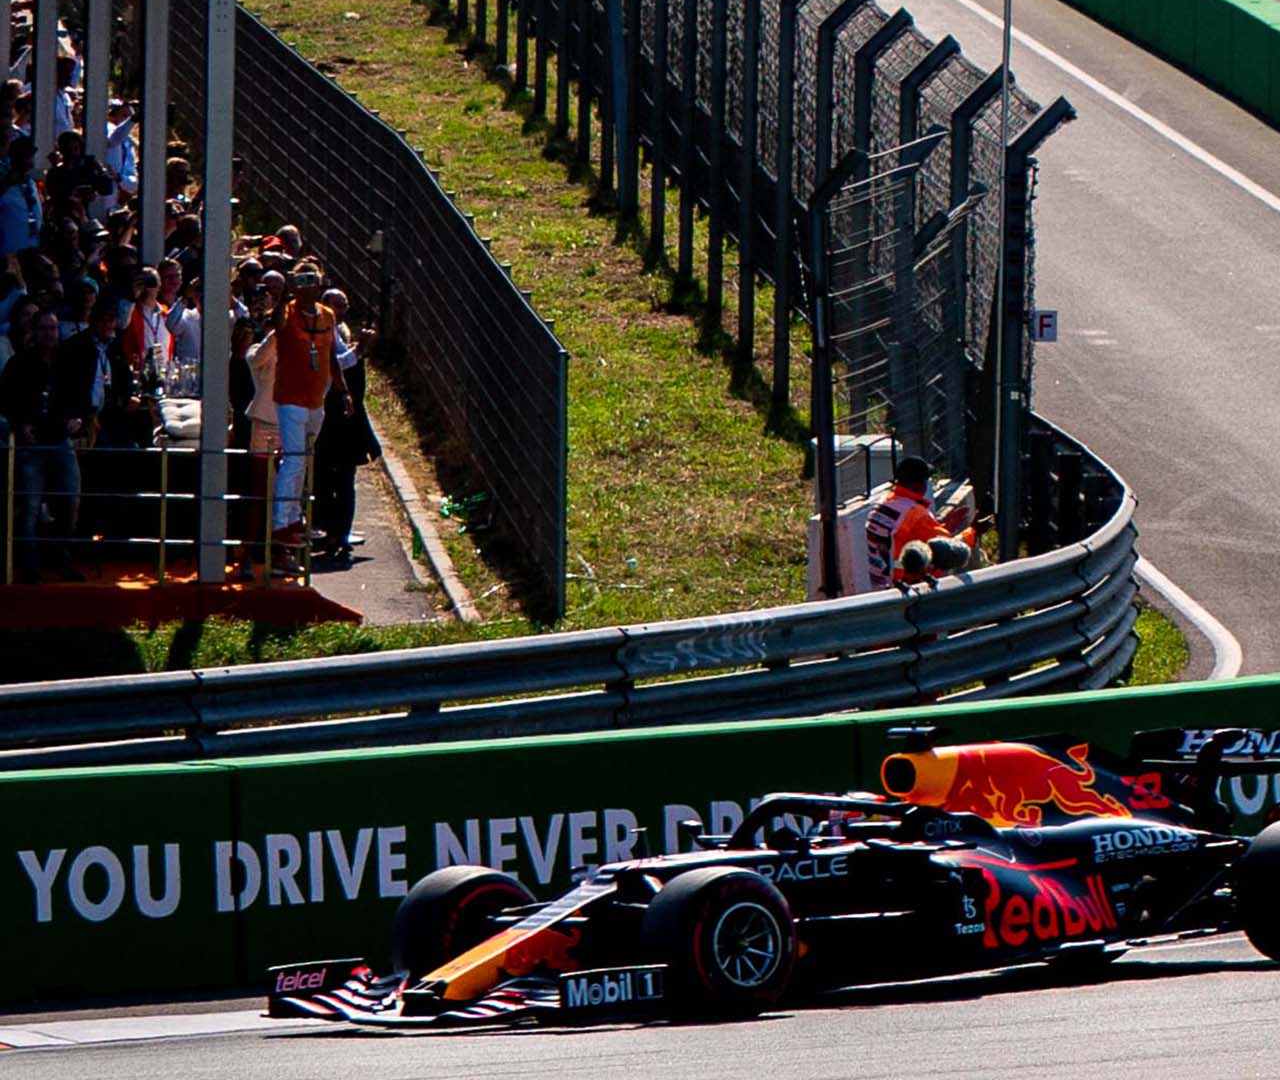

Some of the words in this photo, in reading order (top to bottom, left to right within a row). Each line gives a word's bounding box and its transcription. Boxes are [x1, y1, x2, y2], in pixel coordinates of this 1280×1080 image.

[1039, 315, 1053, 338] F
[1091, 827, 1199, 855] HONDA
[17, 842, 182, 922] YOU
[214, 825, 408, 913] DRIVE
[435, 808, 641, 884] NEVER
[757, 855, 849, 883] RACLE
[275, 967, 327, 993] telcel
[567, 972, 633, 1008] Mobil
[643, 973, 654, 996] 1
